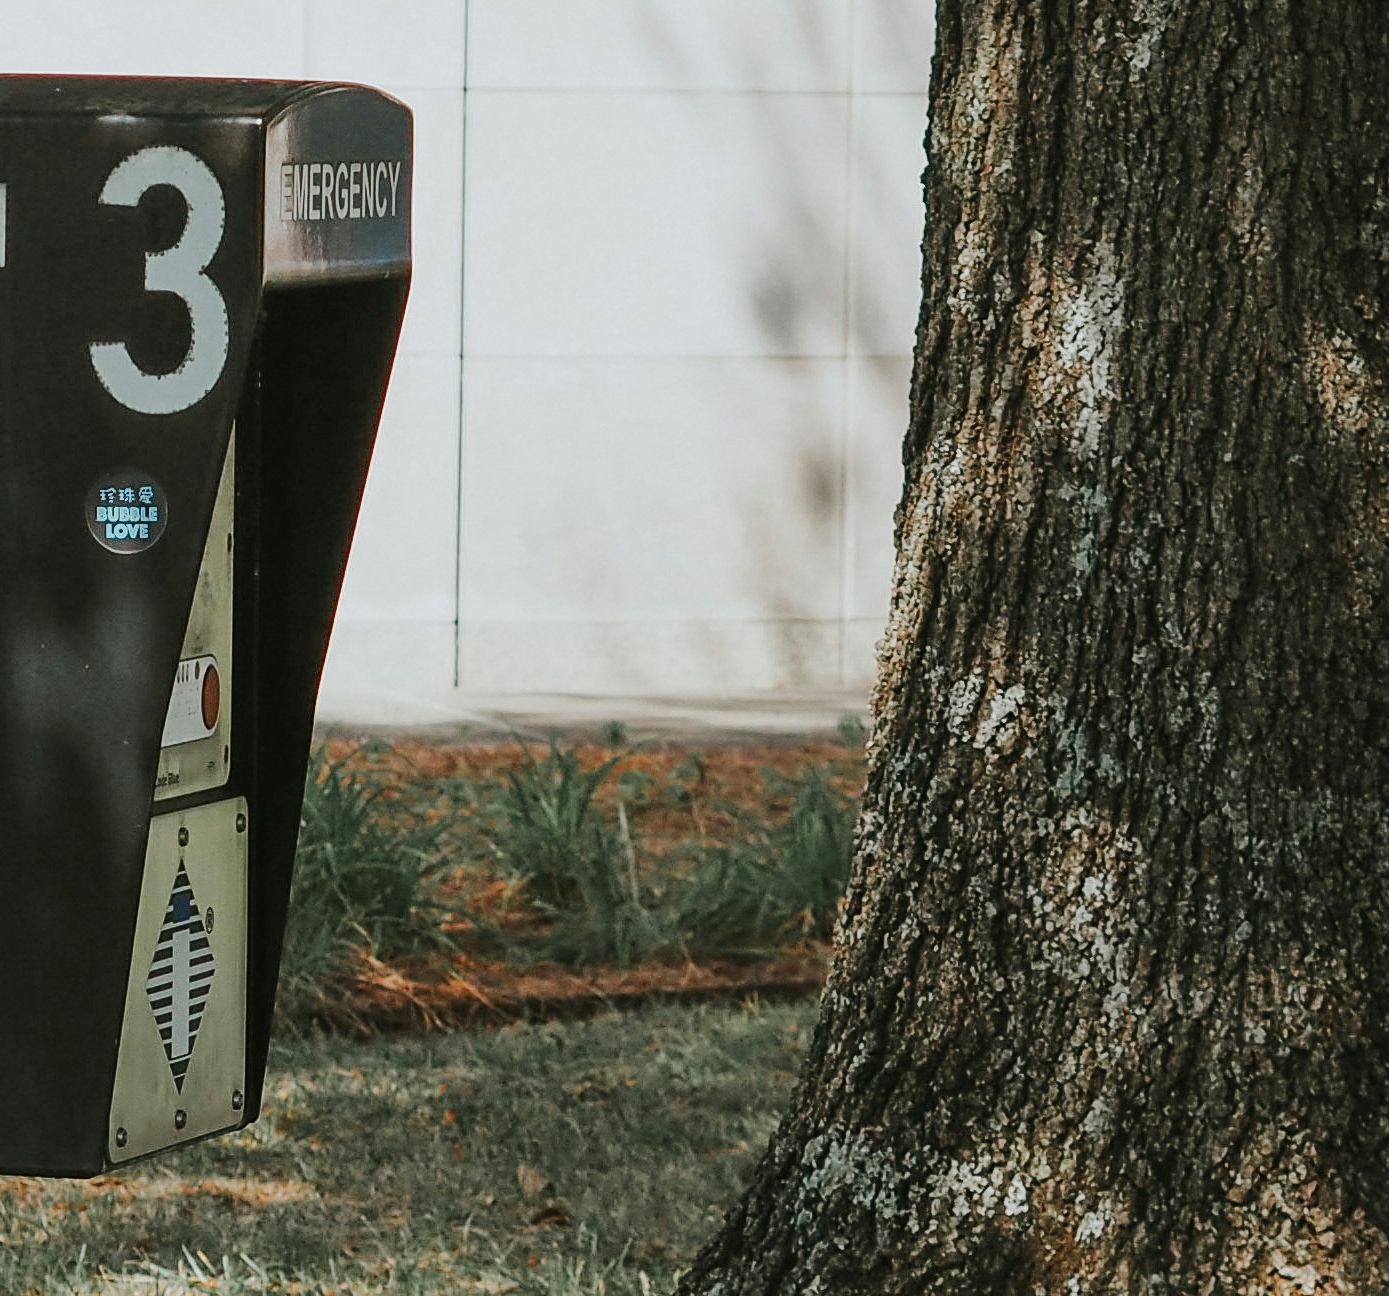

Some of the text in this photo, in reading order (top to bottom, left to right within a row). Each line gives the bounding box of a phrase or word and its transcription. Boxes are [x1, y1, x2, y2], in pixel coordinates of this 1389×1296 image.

[280, 161, 401, 221] EMERGENCY
[89, 145, 229, 415] 3
[96, 506, 158, 522] BUBBLE
[105, 523, 149, 539] LOVE
